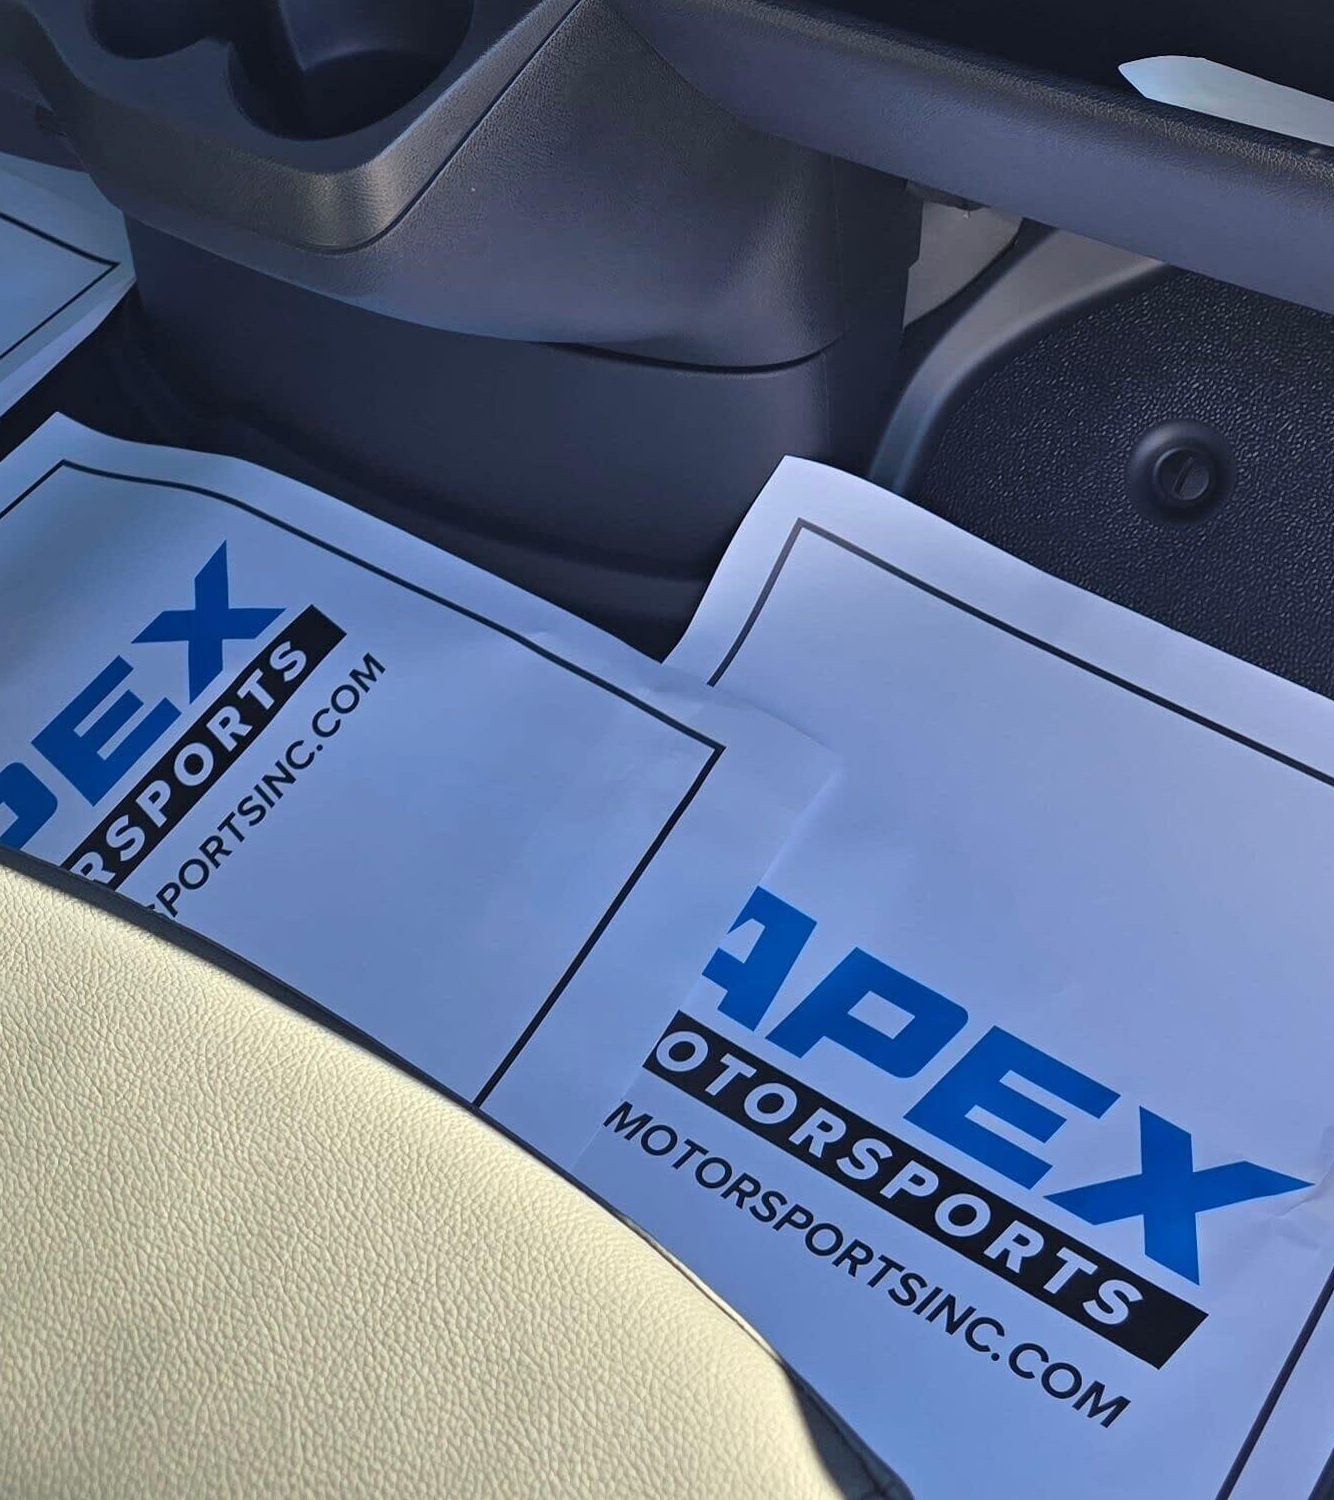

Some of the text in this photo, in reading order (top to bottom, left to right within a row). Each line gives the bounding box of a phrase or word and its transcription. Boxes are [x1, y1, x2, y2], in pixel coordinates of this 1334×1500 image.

[69, 640, 308, 884] RSPORTS
[147, 653, 387, 918] PORTSINC.COM
[656, 1031, 1143, 1327] OTORSPORTS
[701, 884, 1316, 1287] APEX
[603, 1100, 1132, 1430] MOTORSPORTSINC.COM
